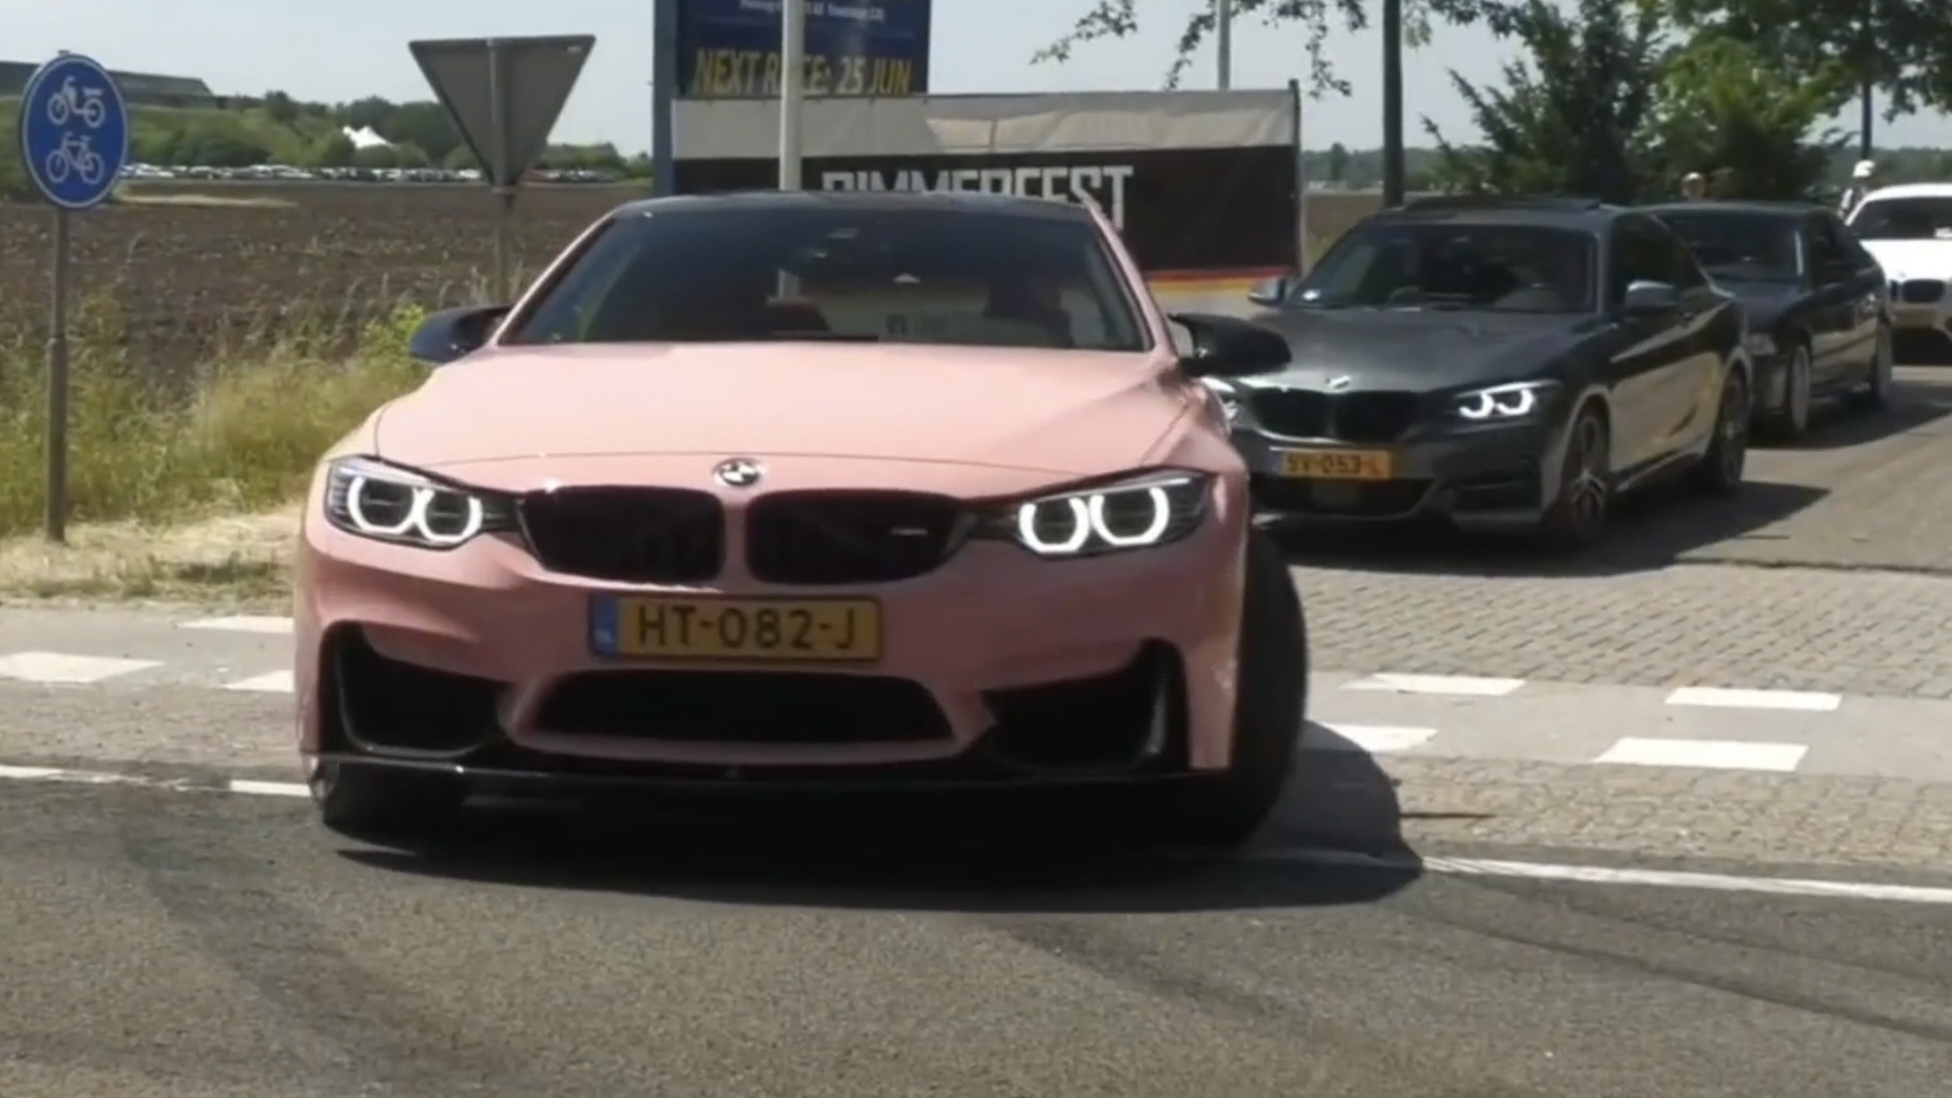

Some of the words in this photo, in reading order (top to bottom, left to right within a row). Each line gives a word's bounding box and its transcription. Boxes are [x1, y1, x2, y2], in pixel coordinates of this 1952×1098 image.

[693, 47, 761, 95] NEXT
[762, 52, 832, 95] RCE:
[836, 56, 867, 95] 25
[867, 57, 912, 95] JUN
[637, 604, 856, 650] HT-082-J
